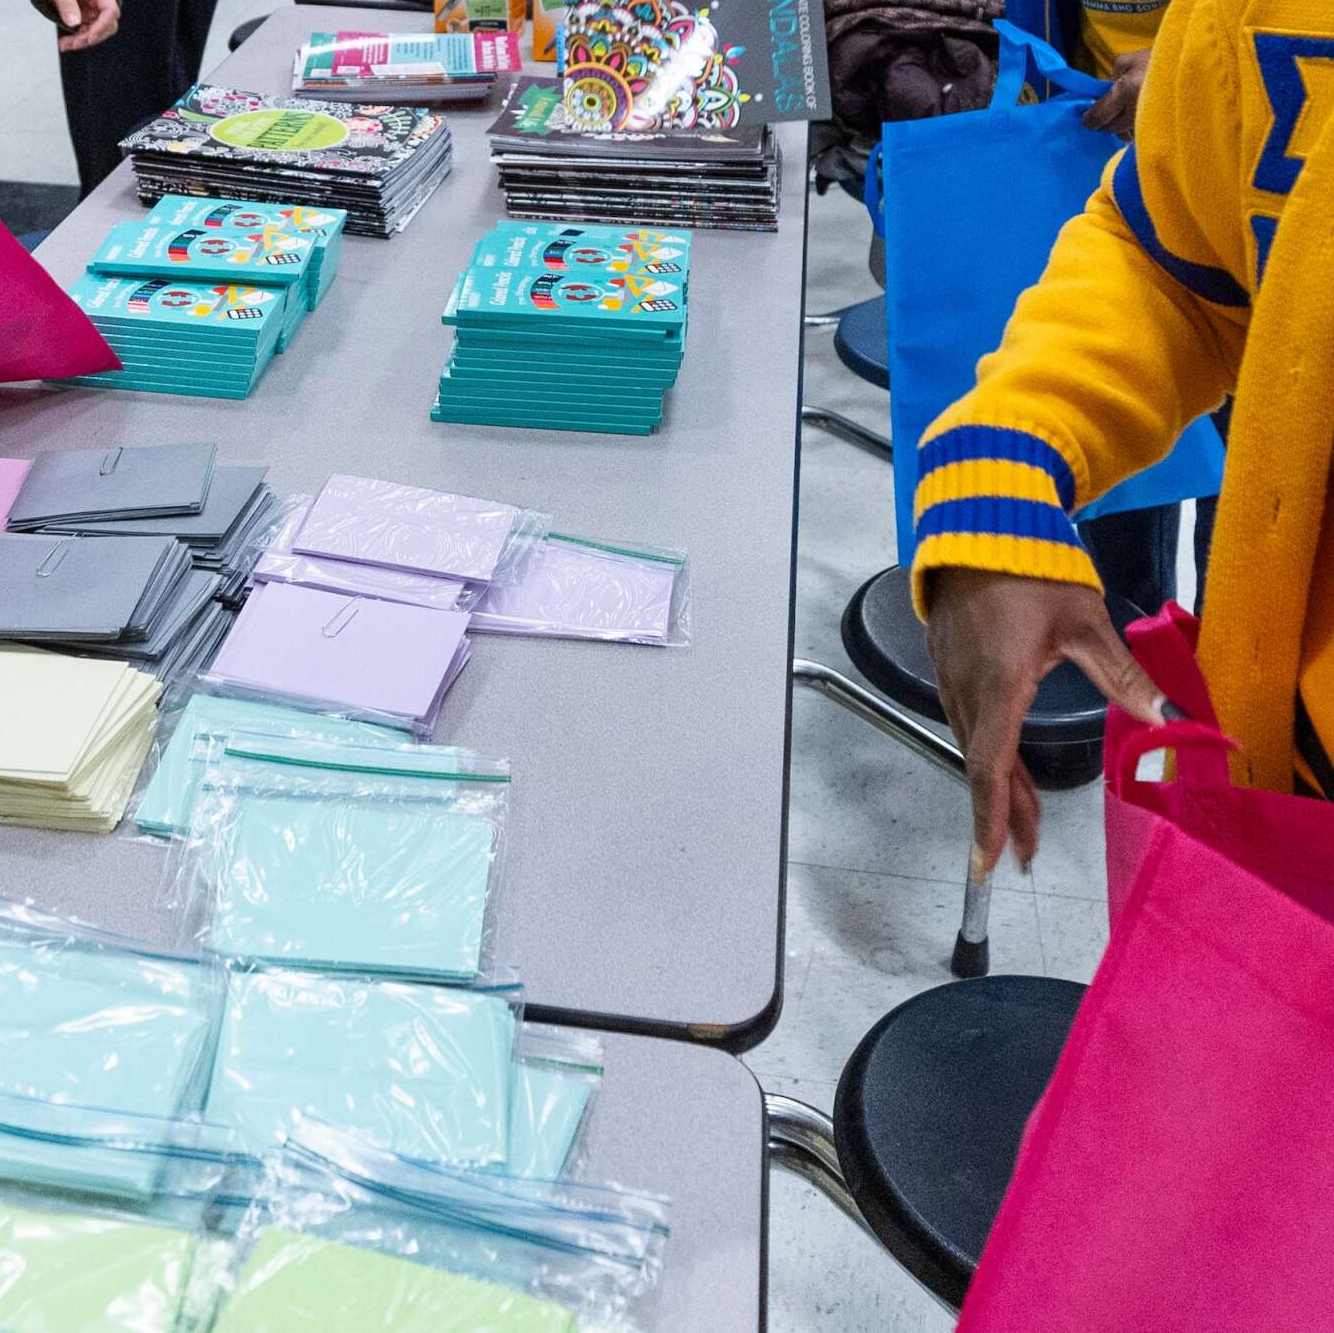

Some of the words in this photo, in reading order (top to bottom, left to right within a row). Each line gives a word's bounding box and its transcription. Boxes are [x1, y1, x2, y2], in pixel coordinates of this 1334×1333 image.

[798, 15, 813, 66] COLORING
[802, 66, 816, 97] BOOK
[805, 97, 817, 111] OF
